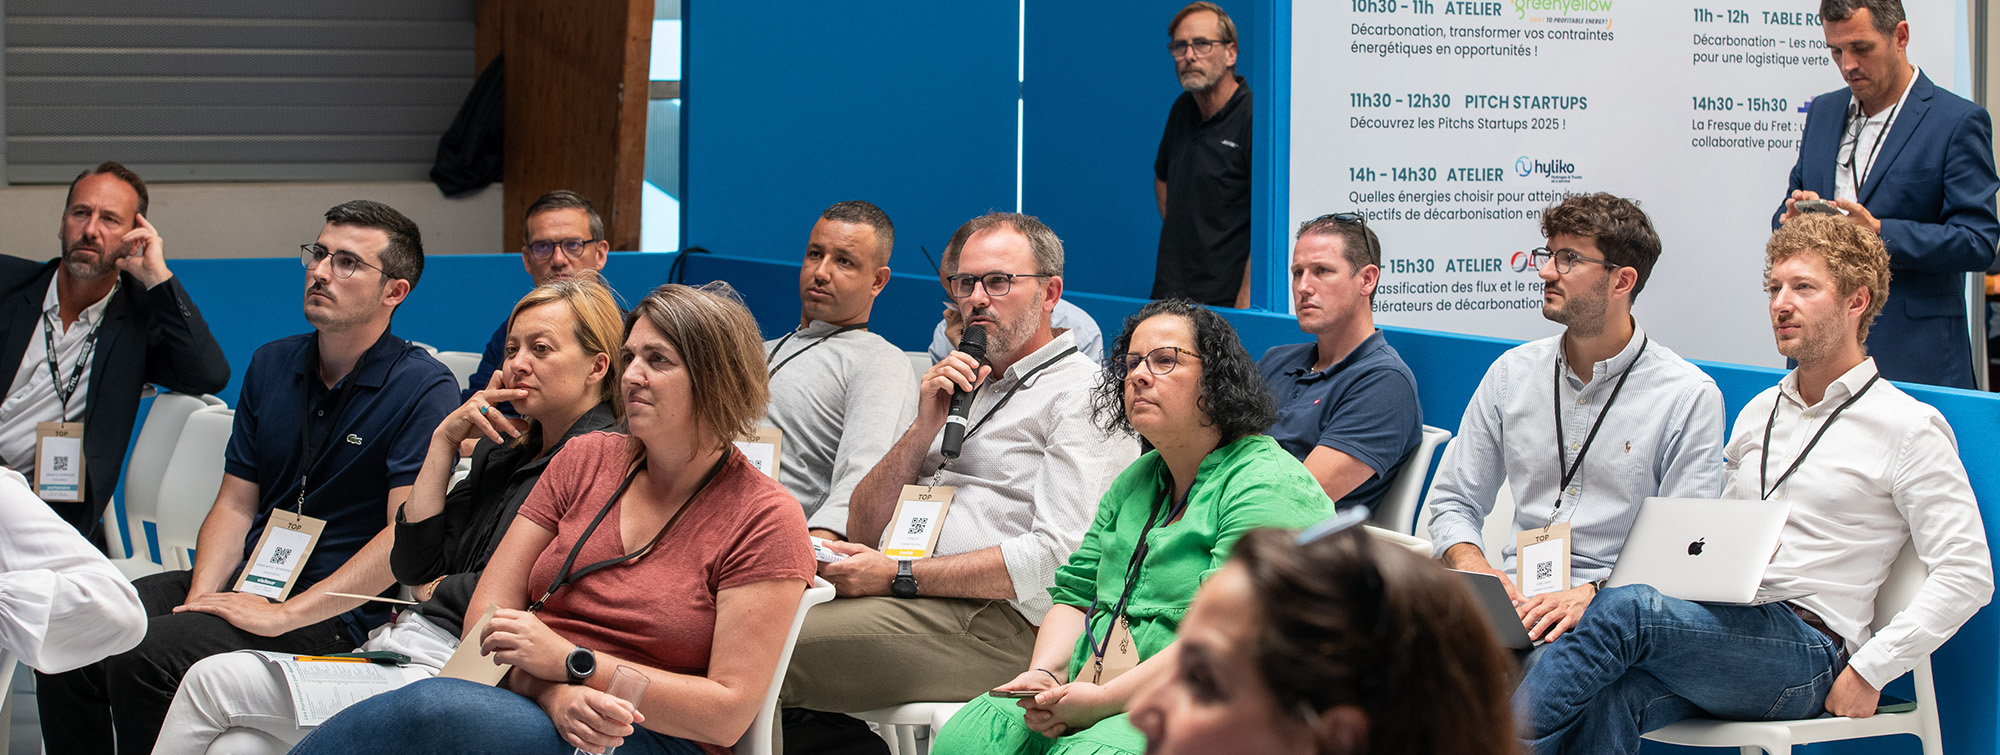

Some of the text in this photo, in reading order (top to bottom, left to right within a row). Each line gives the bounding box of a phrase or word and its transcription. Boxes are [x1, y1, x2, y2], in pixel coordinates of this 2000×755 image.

[1352, 0, 1396, 13] 10h30
[1413, 0, 1433, 14] 11h
[1445, 1, 1501, 16] ATELIER
[1514, 0, 1612, 20] greenyellow
[1694, 9, 1713, 22] 11h
[1727, 10, 1749, 23] 12h
[1762, 11, 1802, 25] TABLE
[1352, 23, 1614, 41] Décarbonation, transformer vos contraintes
[1694, 34, 1775, 47] Décarbonation
[1789, 38, 1806, 48] Les
[1351, 41, 1432, 57] énergétiques
[1436, 45, 1451, 54] en
[1455, 44, 1531, 58] opportunités
[1693, 53, 1829, 67] pour une logistique verte
[1351, 93, 1391, 107] 11h30
[1407, 94, 1450, 108] 12h30
[1465, 95, 1509, 109] PITCH
[1513, 96, 1587, 110] STARTUPS
[1693, 97, 1733, 110] 14h30
[1748, 98, 1787, 112] 15h30
[1351, 116, 1414, 128] Découvrez
[1418, 117, 1434, 129] les
[1439, 117, 1474, 129] Pitchs
[1478, 118, 1527, 133] Startups
[1532, 118, 1559, 129] 2025
[1693, 120, 1704, 130] La
[1708, 120, 1751, 134] Fresque
[1754, 120, 1768, 131] du
[1772, 121, 1791, 131] Fret
[1692, 136, 1764, 148] collaborative
[1768, 139, 1792, 151] pour
[1350, 167, 1375, 181] 14h
[1392, 167, 1436, 181] 14h30
[1447, 168, 1503, 181] ATELIER
[1535, 159, 1574, 178] hyliko
[1349, 191, 1395, 204] Quelles
[1398, 190, 1451, 206] énergies
[1454, 190, 1494, 202] choisir
[1497, 193, 1524, 205] pour
[1356, 208, 1540, 222] bjectifs de décarbonisation en
[1390, 259, 1434, 273] 15h30
[1446, 259, 1502, 272] ATELIER
[1377, 281, 1448, 294] assification
[1451, 281, 1473, 293] des
[1477, 281, 1497, 292] flux
[1500, 281, 1511, 292] et
[1515, 280, 1525, 292] le
[1436, 299, 1451, 311] de
[1454, 297, 1544, 311] décarbonation
